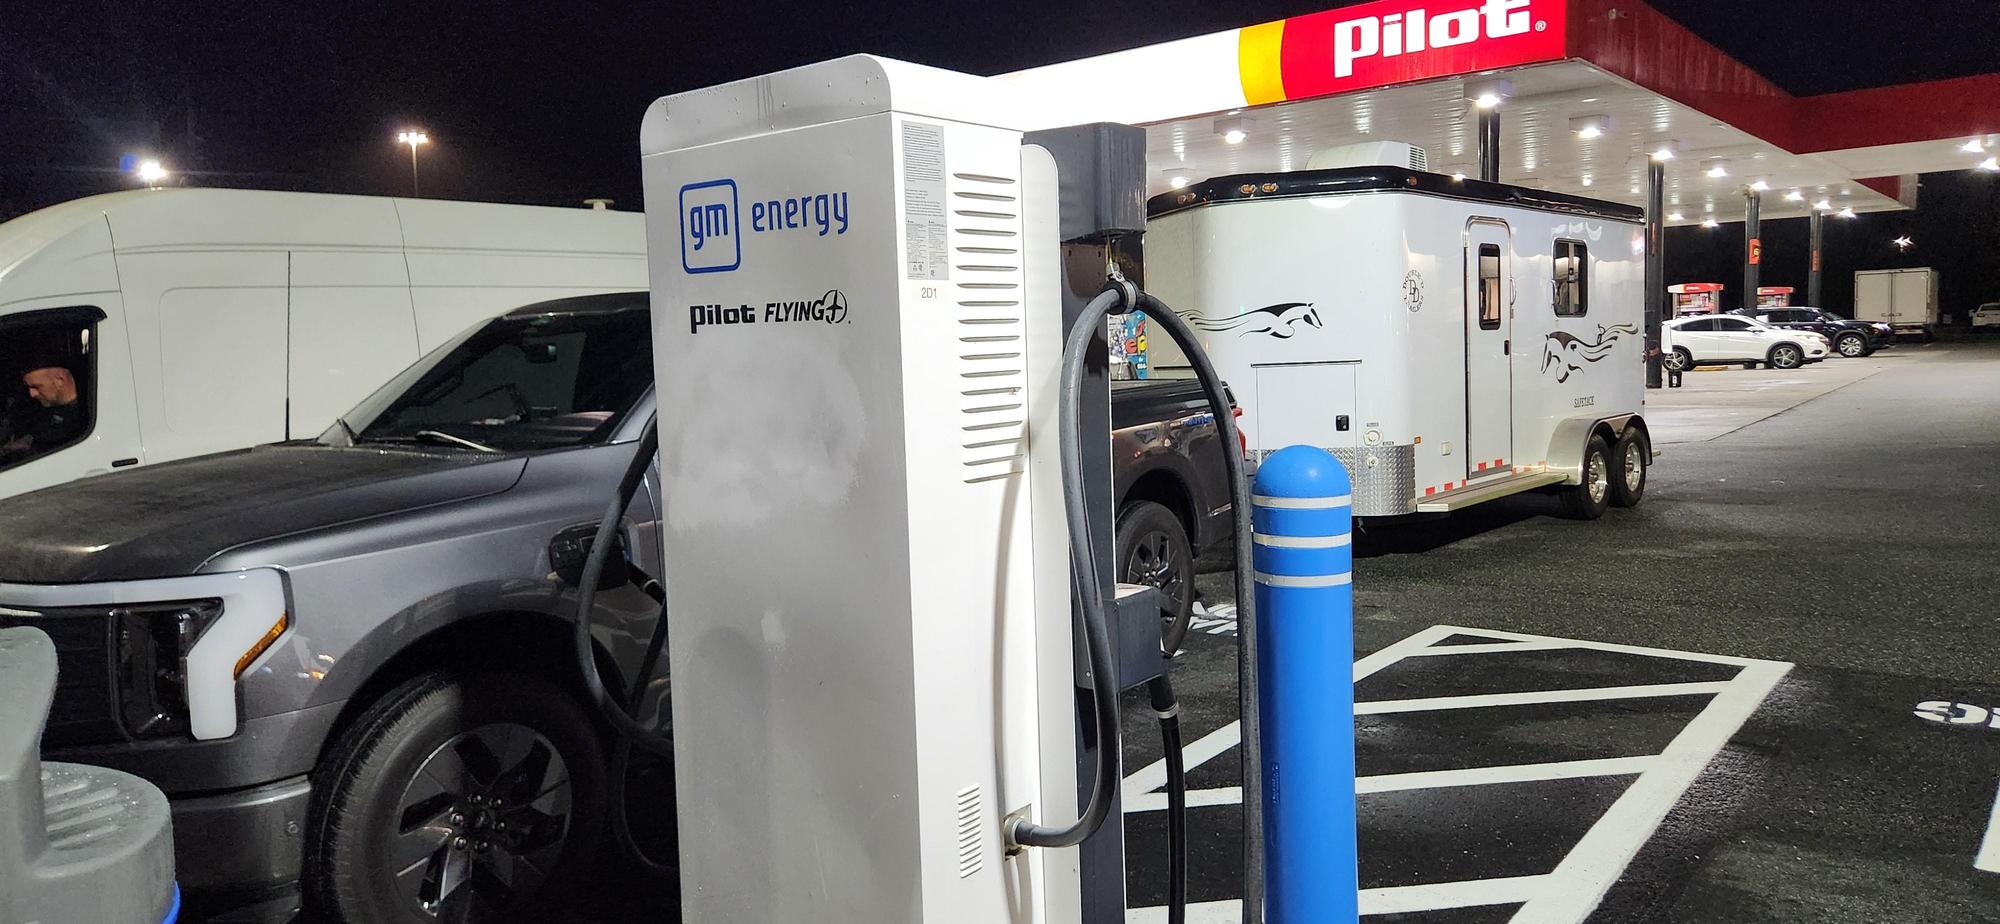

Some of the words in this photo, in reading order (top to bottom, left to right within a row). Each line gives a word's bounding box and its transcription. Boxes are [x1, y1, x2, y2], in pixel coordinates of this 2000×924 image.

[689, 203, 728, 251] gm
[752, 191, 849, 236] energy
[921, 286, 937, 299] 2D1
